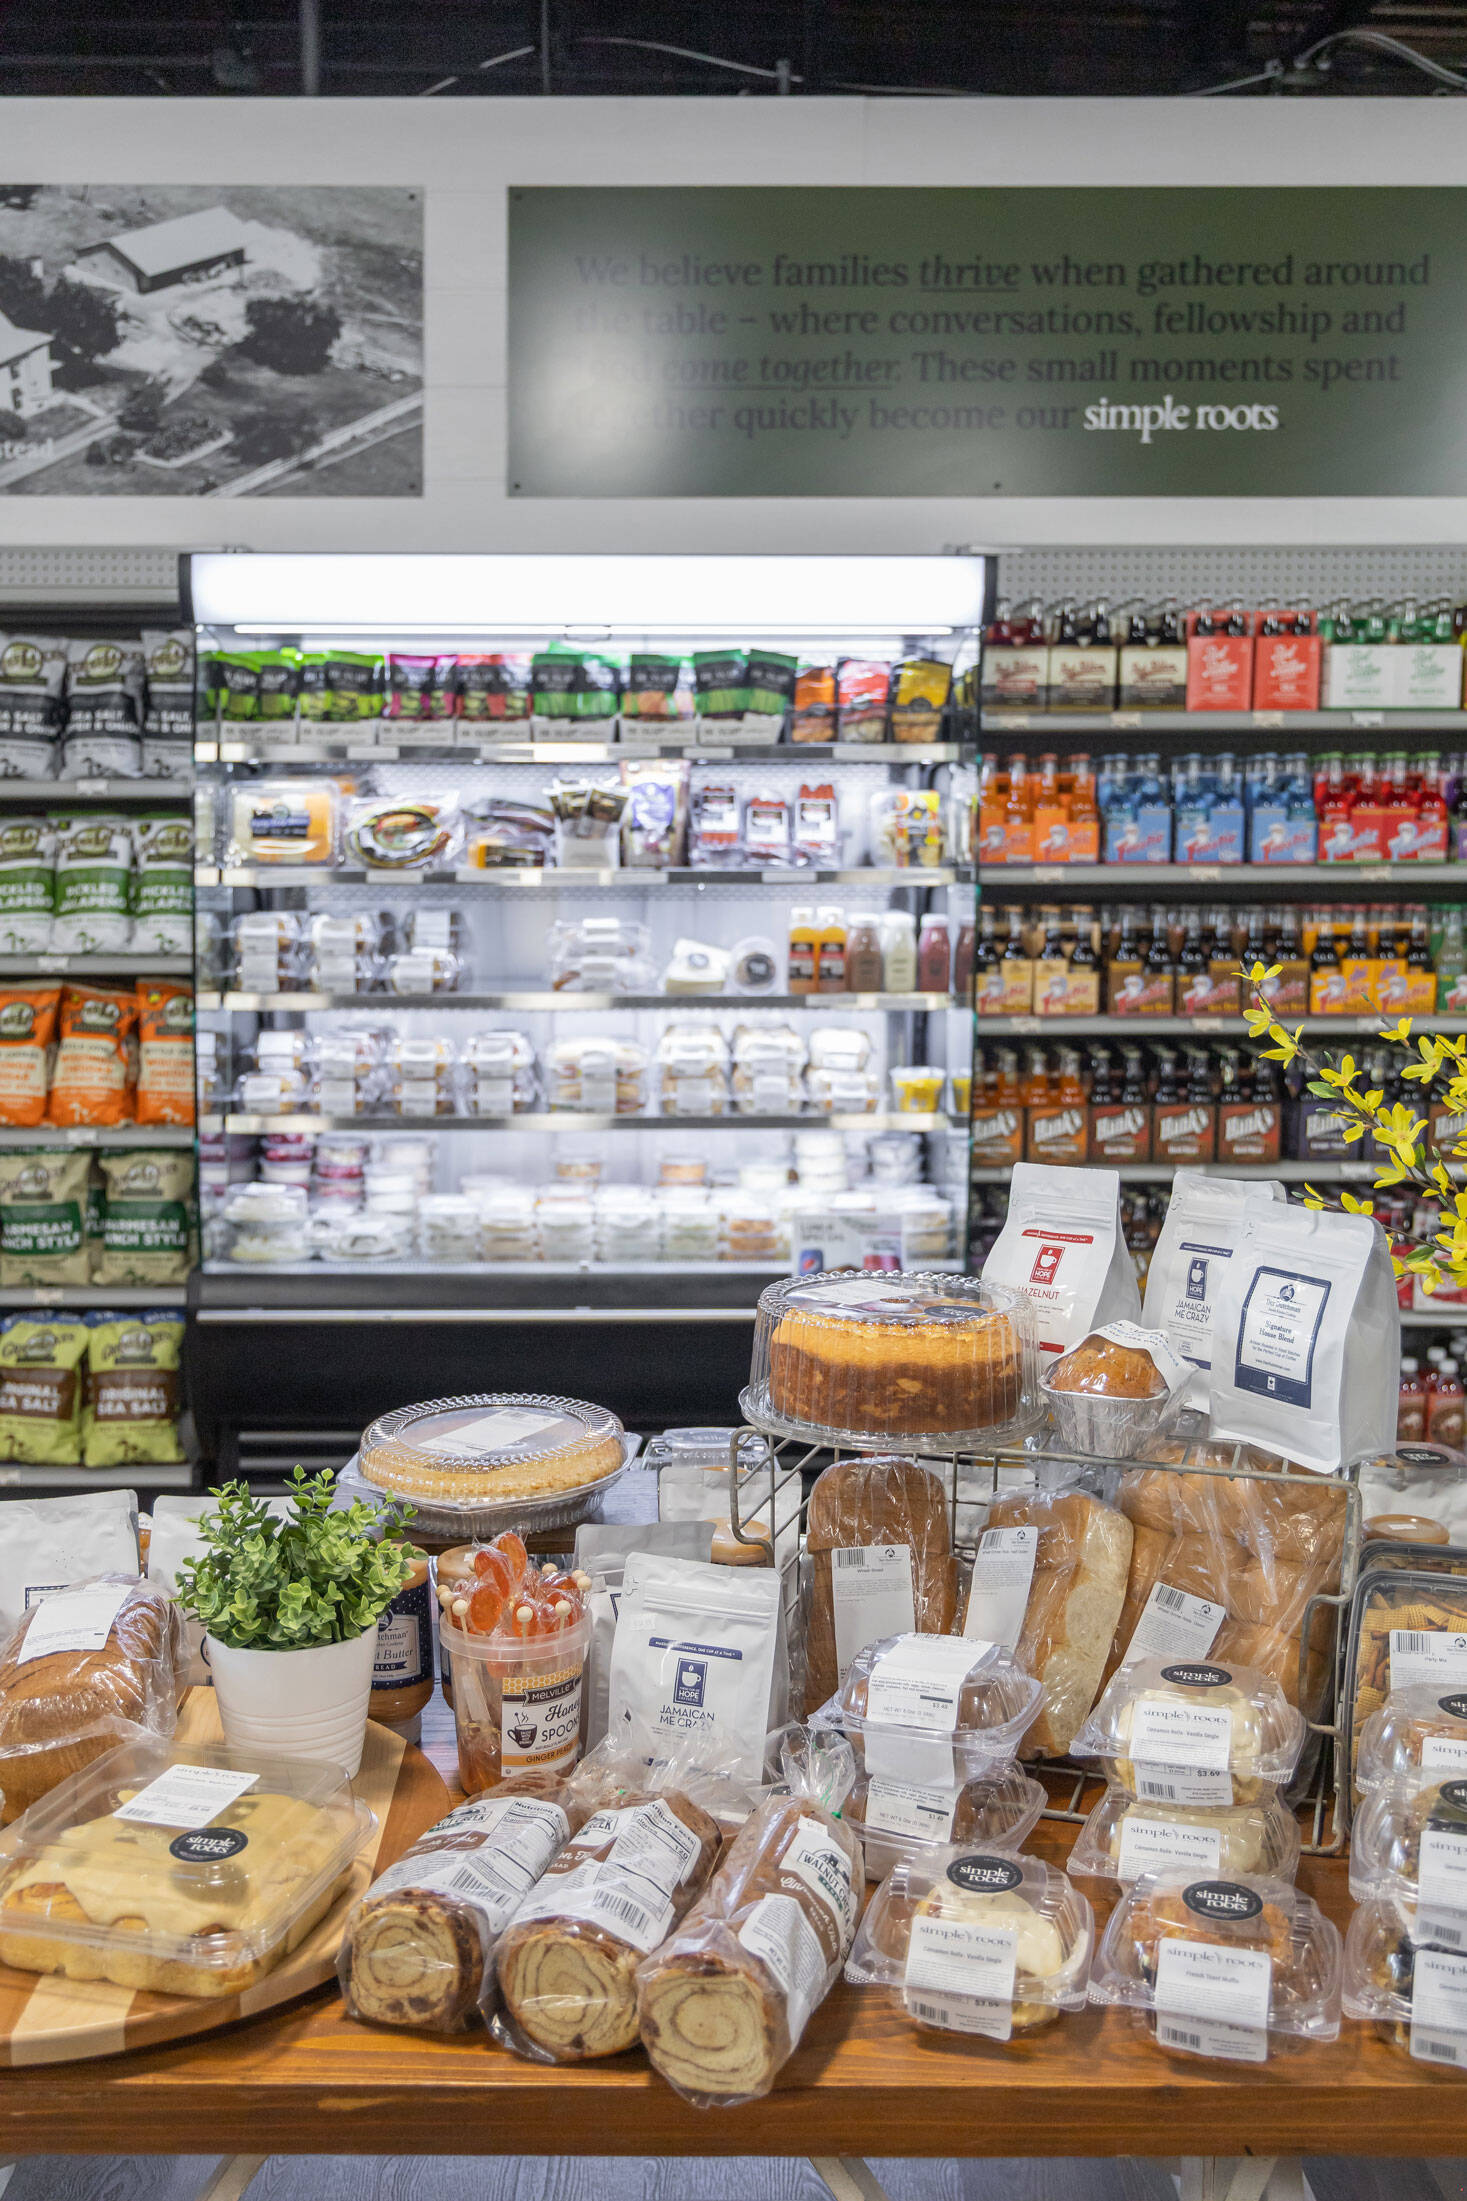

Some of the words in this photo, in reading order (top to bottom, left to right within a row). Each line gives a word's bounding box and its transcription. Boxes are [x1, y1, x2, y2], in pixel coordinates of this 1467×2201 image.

[574, 255, 629, 287] We
[639, 253, 762, 287] believe
[773, 253, 909, 287] families
[919, 255, 1020, 290] thrive
[1031, 254, 1127, 287] when
[1135, 254, 1293, 297] gathered
[1304, 253, 1431, 287] around
[642, 302, 727, 335] table
[769, 303, 880, 335] where
[888, 303, 1143, 339] conversations,
[1153, 302, 1331, 343] fellowship
[1341, 302, 1407, 335] and
[661, 355, 748, 387] come
[759, 352, 900, 392] together.
[912, 350, 1017, 383] These
[1027, 349, 1118, 383] small
[1130, 353, 1292, 384] moments
[1303, 356, 1400, 390] spent
[733, 399, 858, 441] quickly
[869, 400, 1006, 432] become
[1015, 404, 1072, 432] our
[1083, 395, 1189, 444] simple
[1175, 1300, 1212, 1314] JAMAICAN
[1174, 1309, 1186, 1319] ME
[1185, 1311, 1210, 1323] CRAZY
[1265, 1320, 1292, 1334] Signature
[1259, 1327, 1276, 1339] House
[1278, 1333, 1295, 1344] Blend
[384, 1649, 414, 1660] Butter
[1173, 1670, 1220, 1679] simple
[1183, 1675, 1219, 1683] roots
[679, 1689, 699, 1700] HOPE
[660, 1704, 715, 1721] JAMAICAN
[1143, 1710, 1184, 1720] simple
[1194, 1714, 1228, 1724] roots
[660, 1715, 675, 1726] ME
[526, 1750, 554, 1763] GINGER
[1196, 1769, 1221, 1777] $3.69
[515, 1801, 554, 1815] Nutrition
[186, 1835, 236, 1848] simple
[1130, 1826, 1173, 1838] simple
[1182, 1834, 1216, 1843] roots
[188, 1843, 230, 1855] roots
[803, 1853, 838, 1889] WALNUT
[959, 1865, 1010, 1878] simple
[968, 1874, 1009, 1885] roots
[1195, 1889, 1249, 1904] simple
[1206, 1899, 1249, 1912] roots
[919, 1925, 966, 1940] simple
[975, 1935, 1012, 1947] roots
[1167, 1946, 1215, 1962] simple
[1225, 1957, 1264, 1969] roots
